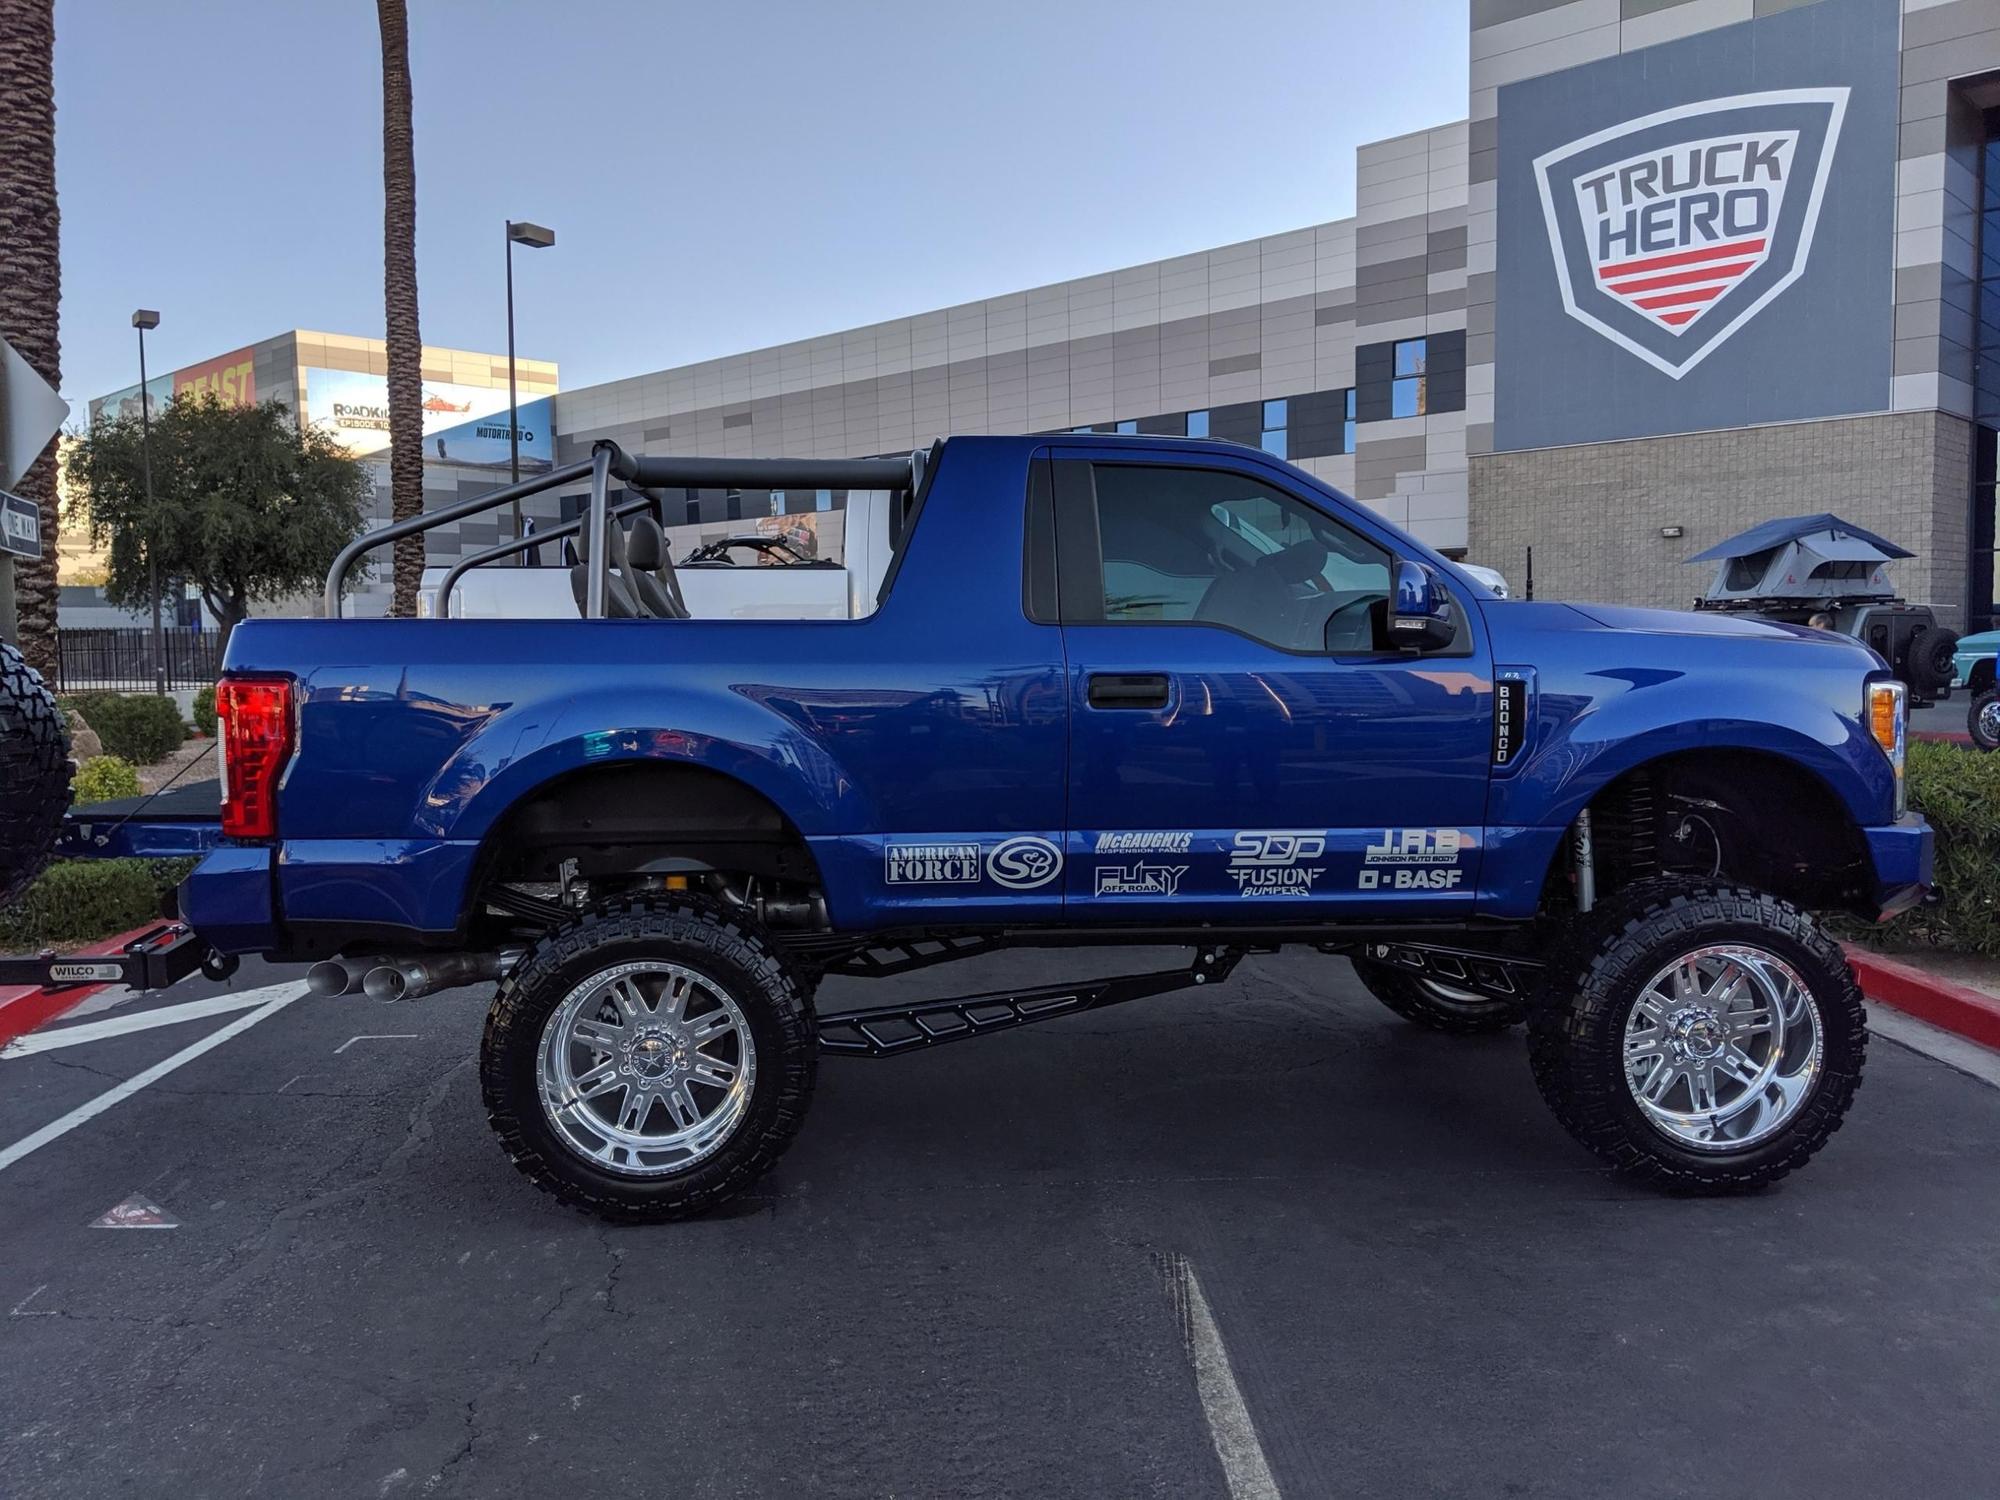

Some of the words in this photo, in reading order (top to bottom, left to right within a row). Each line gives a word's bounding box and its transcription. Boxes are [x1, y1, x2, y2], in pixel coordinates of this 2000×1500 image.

[1581, 139, 1789, 215] TRUCK
[1599, 188, 1769, 261] HERO
[340, 419, 377, 429] EPISODE
[476, 427, 523, 441] MOTORTRD
[8, 511, 20, 536] ONE
[21, 517, 36, 541] WAY
[1497, 686, 1510, 762] BRONCO
[1095, 832, 1194, 849] McGAUGHYS
[889, 846, 977, 861] AMERICAN
[889, 859, 977, 881] FORCE
[1095, 860, 1190, 898] FURY
[1235, 868, 1316, 889] FUSION
[1395, 869, 1462, 888] BASF
[1241, 885, 1310, 898] BUMPERS
[55, 967, 94, 976] WILCO
